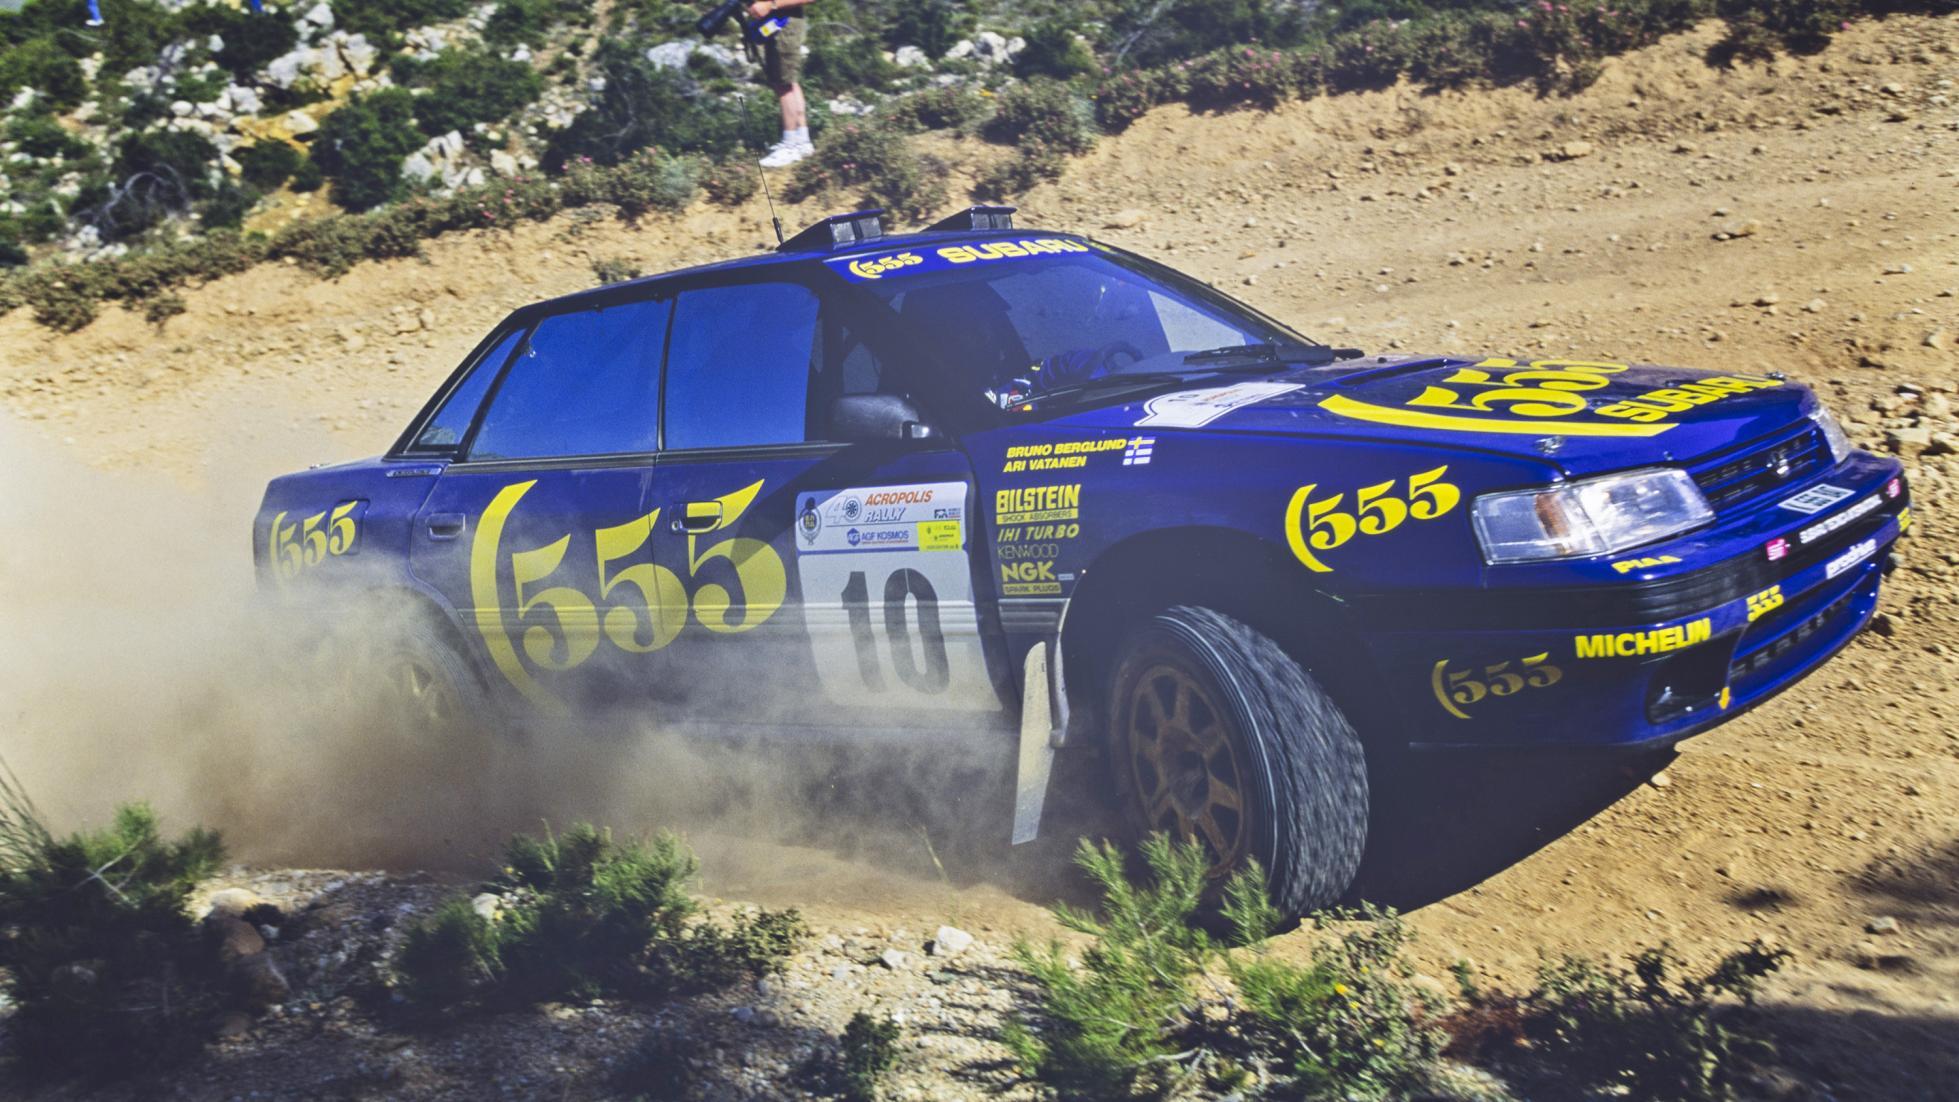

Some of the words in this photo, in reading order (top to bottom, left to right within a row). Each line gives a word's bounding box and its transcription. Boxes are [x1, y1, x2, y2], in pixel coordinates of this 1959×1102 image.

[936, 239, 1089, 264] SUBARU
[1594, 373, 1785, 423] SUBARU
[1006, 444, 1053, 458] BRUNO
[1053, 438, 1127, 455] BERGLUND
[1002, 459, 1027, 473] ARI
[1029, 455, 1088, 471] VATANEN
[864, 489, 934, 506] ACROPOLIS
[995, 484, 1082, 513] BILSTEIN
[864, 507, 906, 523] RALLY
[997, 527, 1021, 543] IHI
[1026, 523, 1080, 541] TURBO
[997, 543, 1060, 560] KENWOOD
[1001, 560, 1056, 583] NGK
[1611, 555, 1682, 574] PIAA
[1746, 584, 1785, 622] 555
[840, 567, 950, 695] 10
[1575, 617, 1712, 659] MICHELIN
